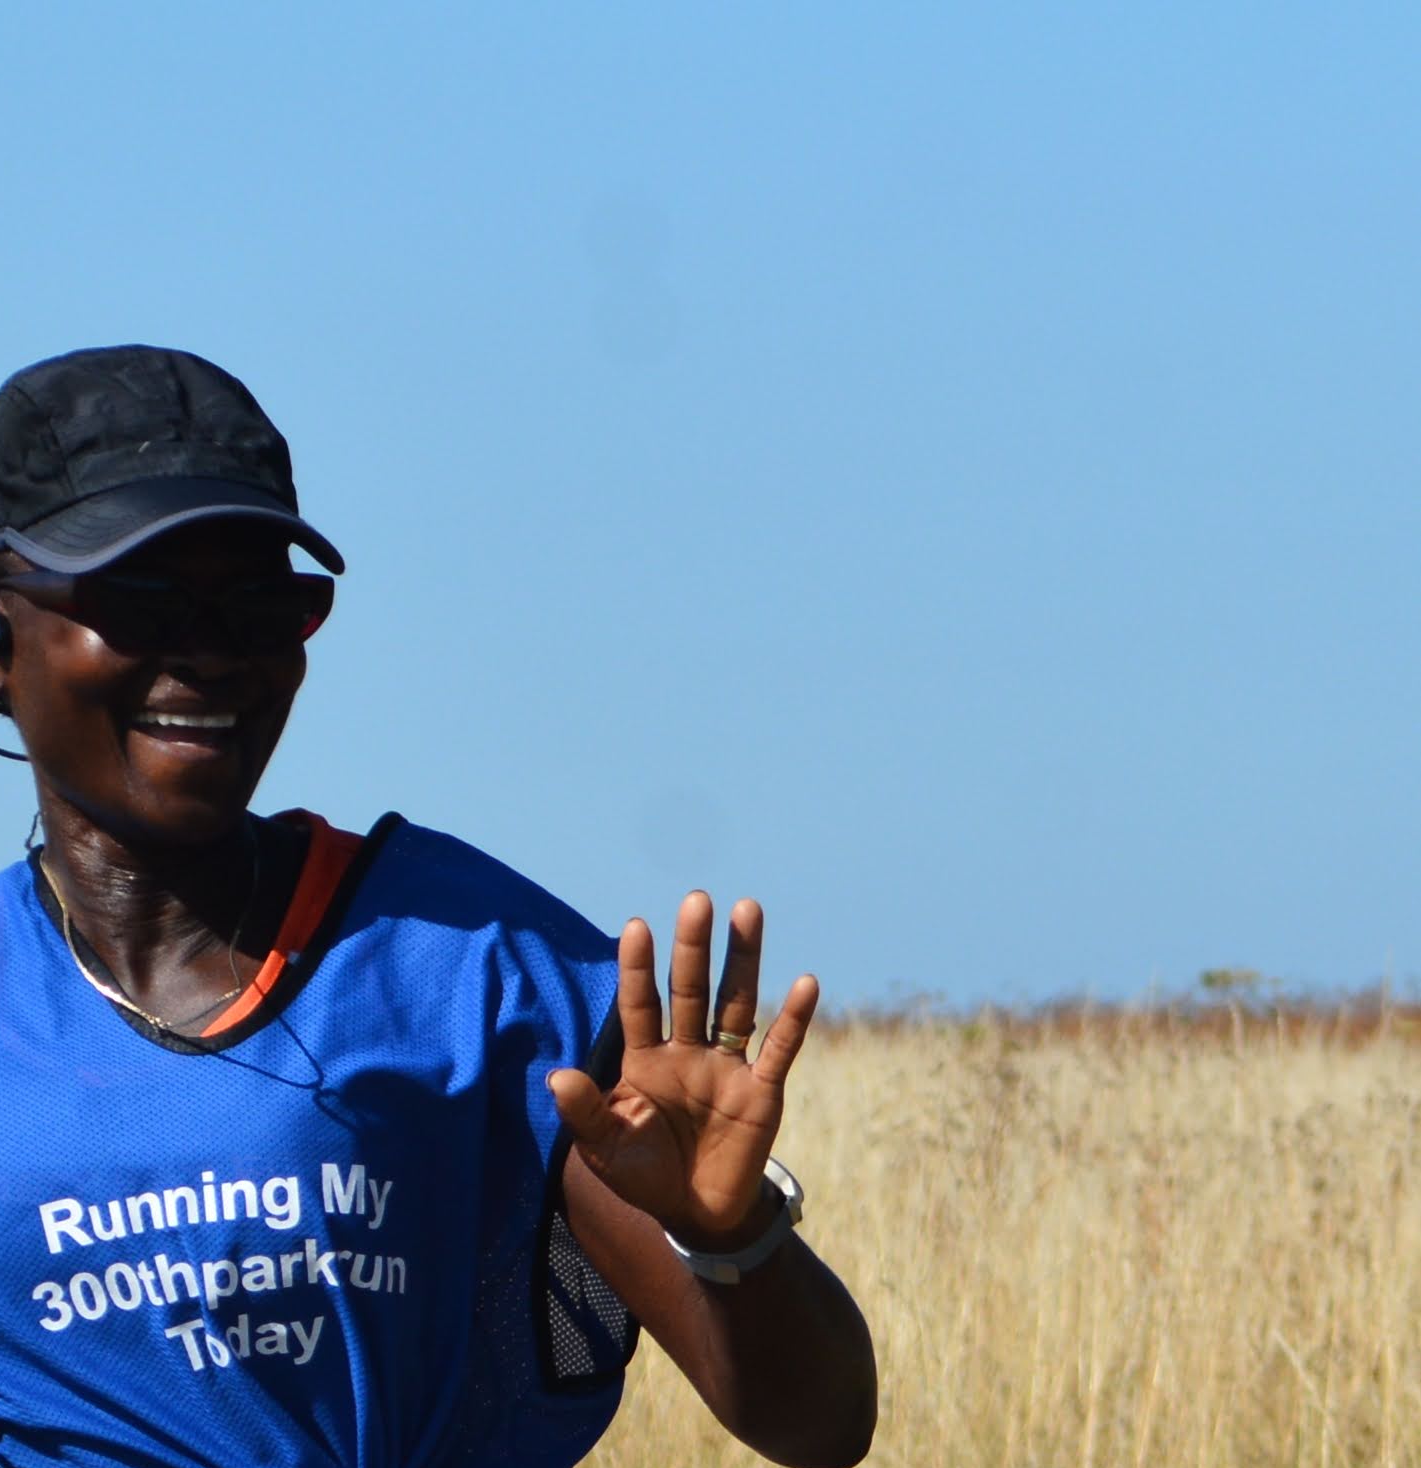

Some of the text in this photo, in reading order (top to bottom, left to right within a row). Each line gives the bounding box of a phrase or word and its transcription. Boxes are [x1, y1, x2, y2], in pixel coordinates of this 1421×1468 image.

[39, 1163, 393, 1255] Running My
[32, 1239, 407, 1332] 300thparkrun
[165, 1313, 325, 1372] Today
